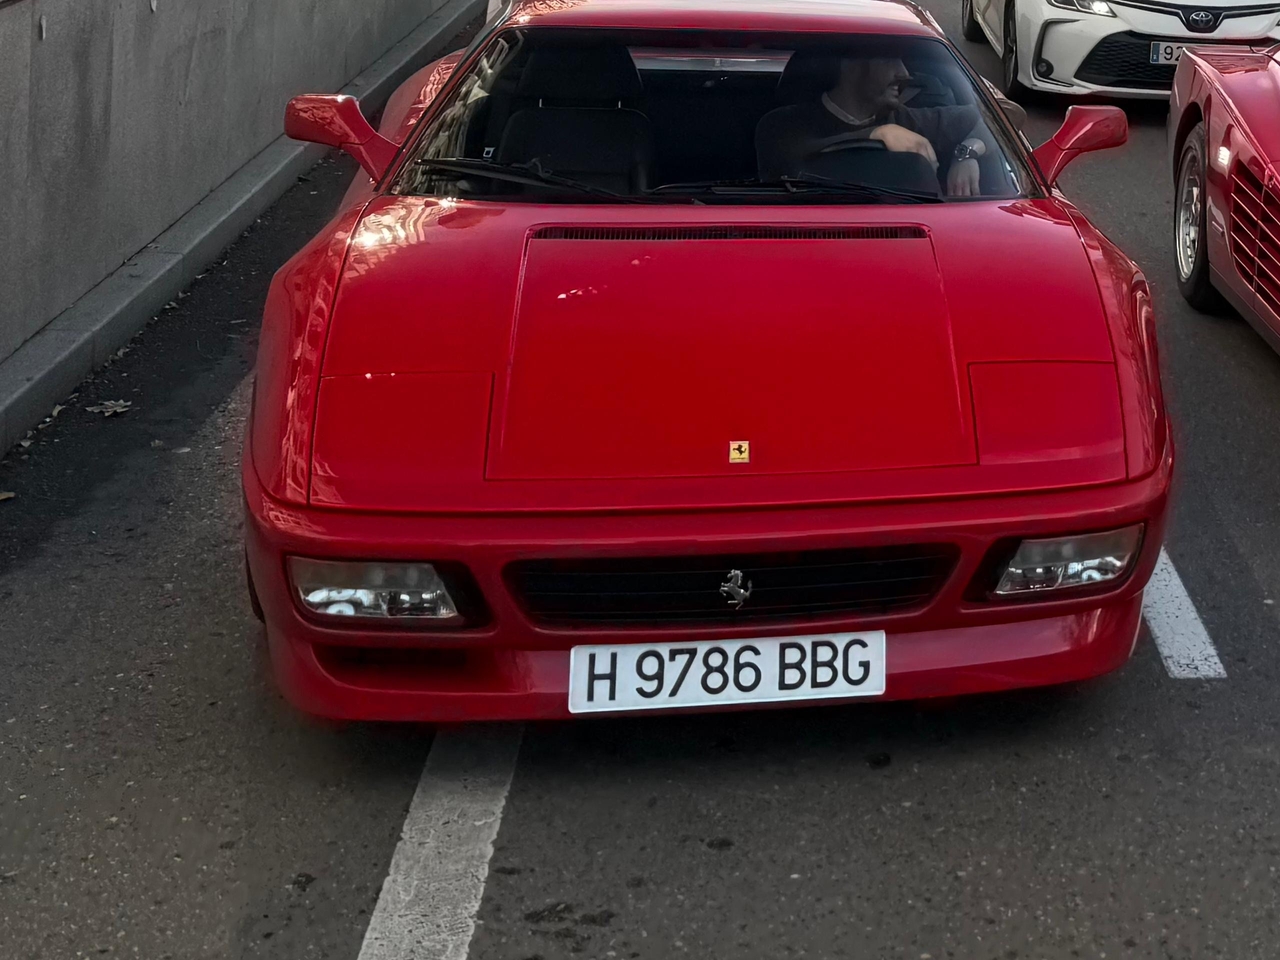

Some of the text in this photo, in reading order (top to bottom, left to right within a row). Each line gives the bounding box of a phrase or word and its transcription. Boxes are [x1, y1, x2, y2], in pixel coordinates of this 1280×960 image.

[1164, 46, 1183, 61] 92
[587, 639, 870, 702] H 9786 BBG
